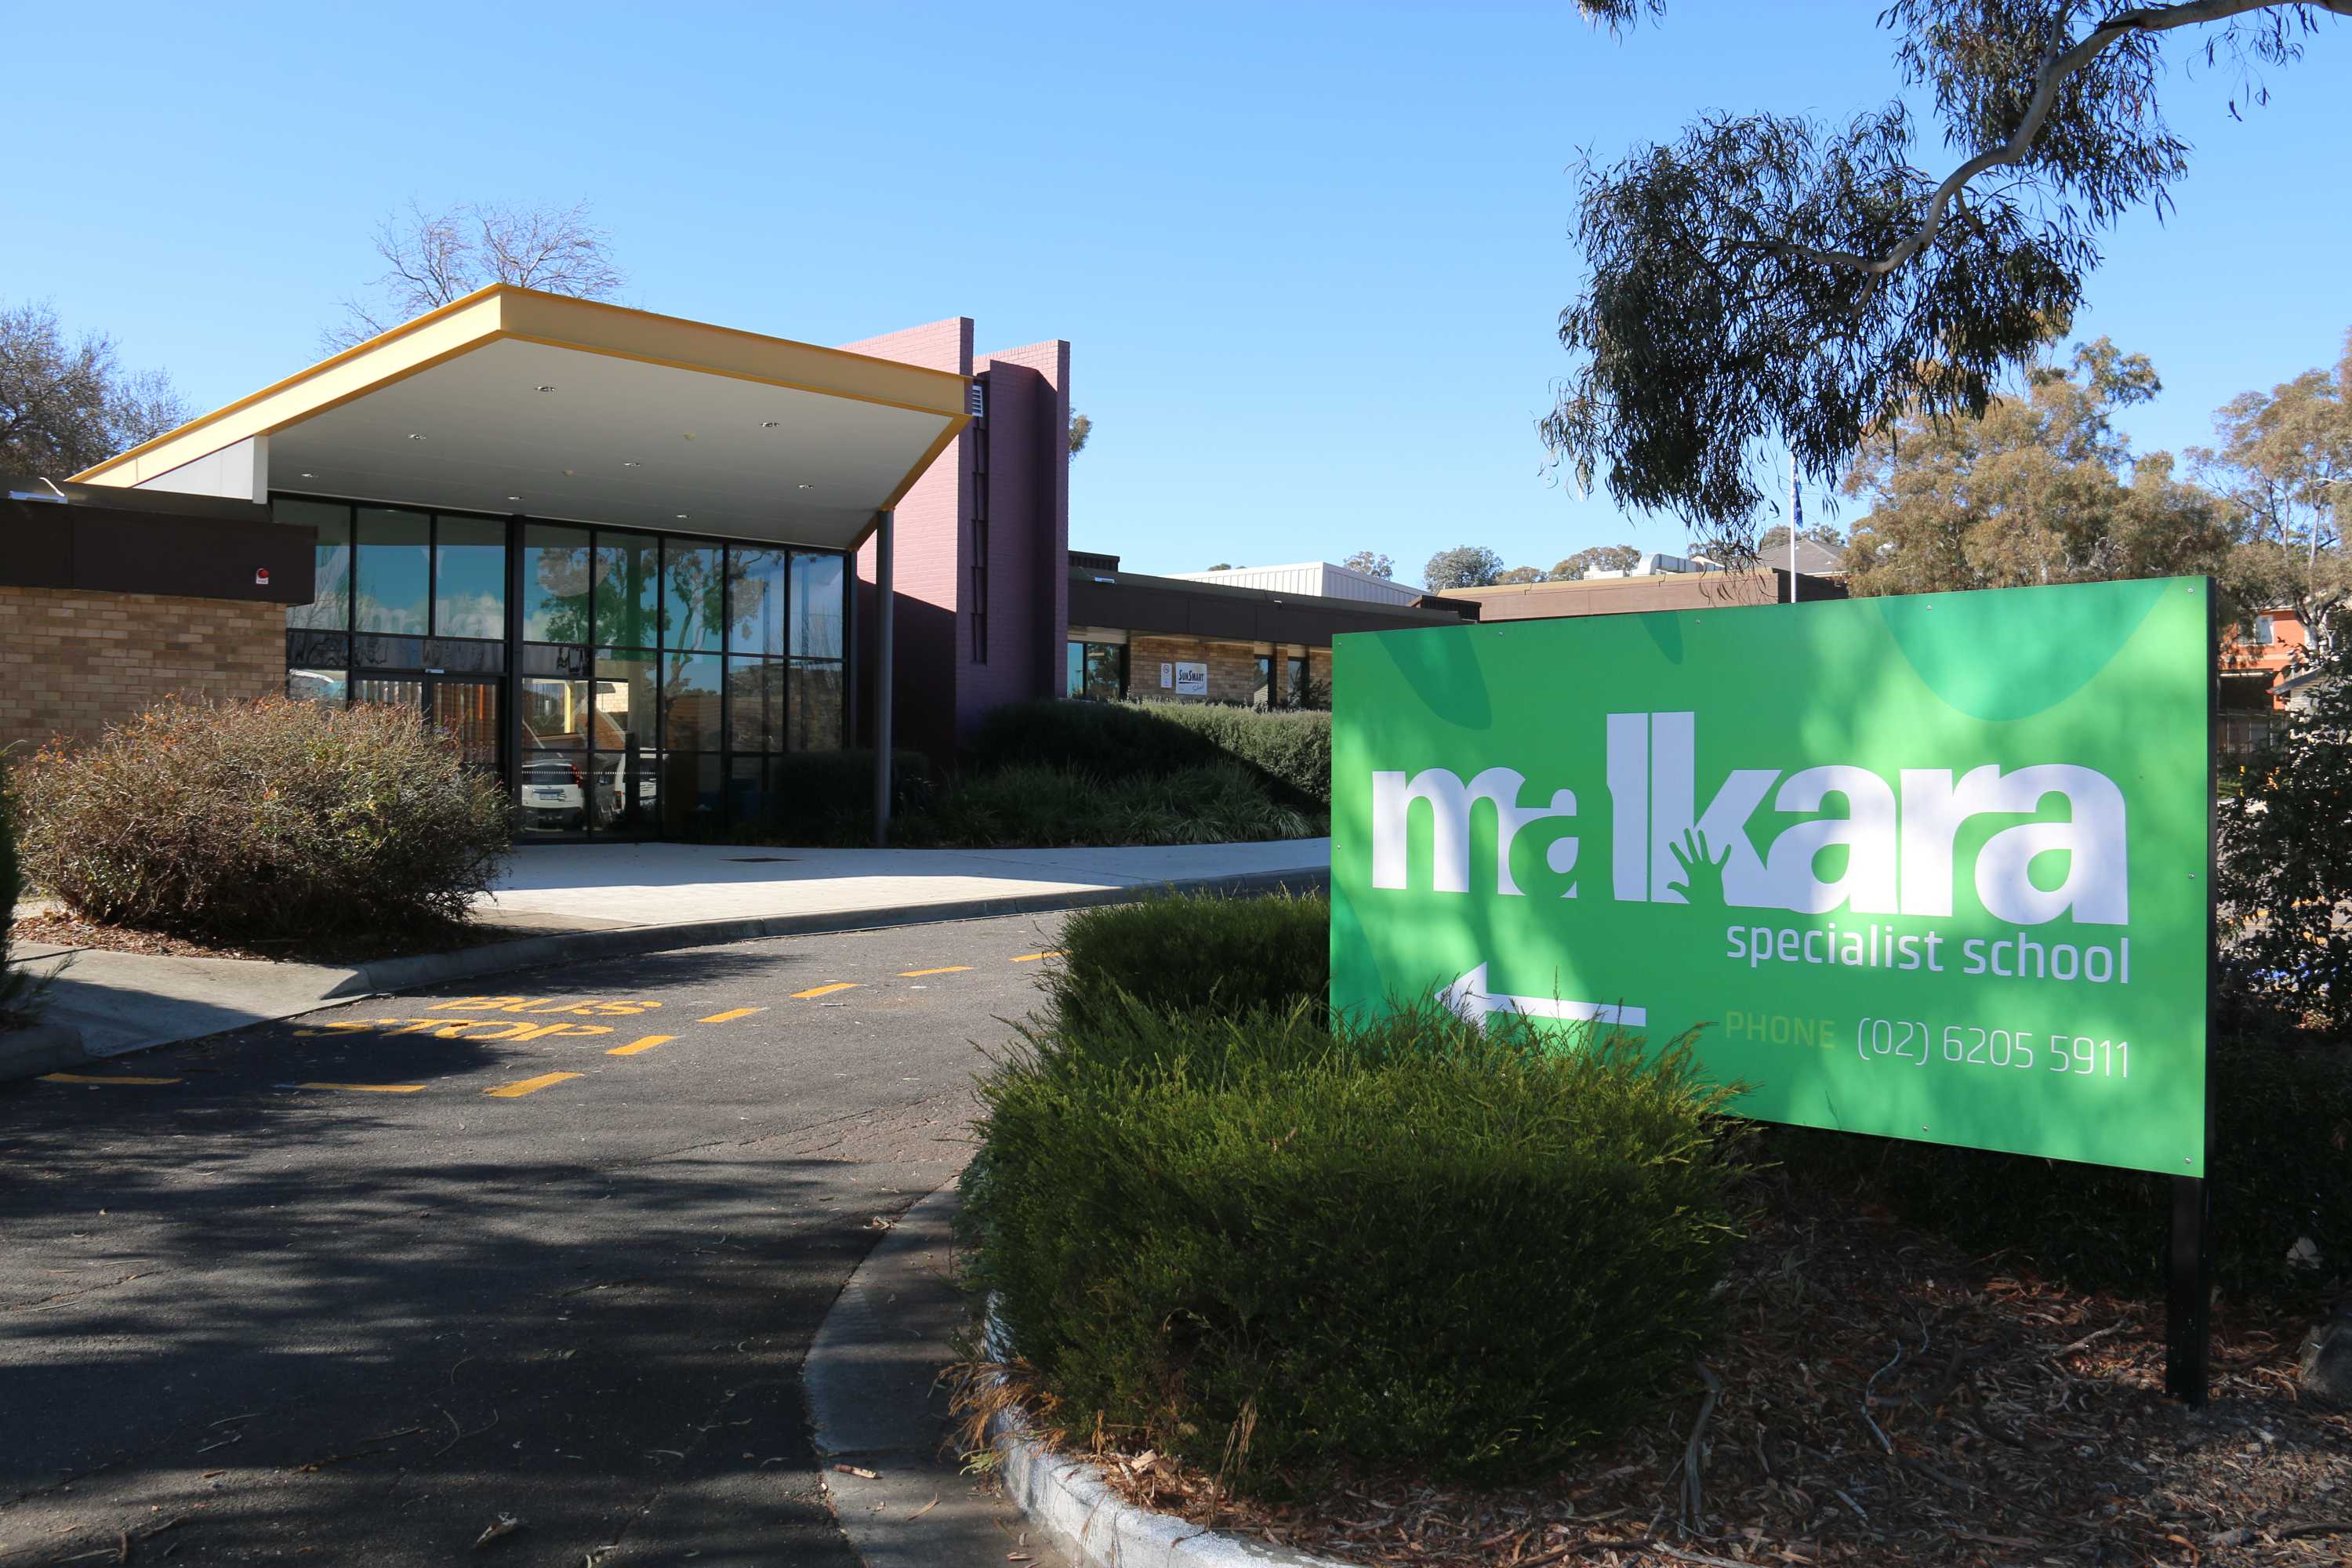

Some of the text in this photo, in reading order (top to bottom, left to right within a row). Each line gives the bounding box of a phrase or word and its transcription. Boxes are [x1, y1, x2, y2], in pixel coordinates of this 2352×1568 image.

[1371, 711, 2129, 926] malkara
[1726, 921, 2129, 984] specialist school
[292, 1018, 616, 1043] STOP
[426, 996, 663, 1016] BUS
[1725, 1011, 2129, 1079] PHONE (02) 6205 5911
